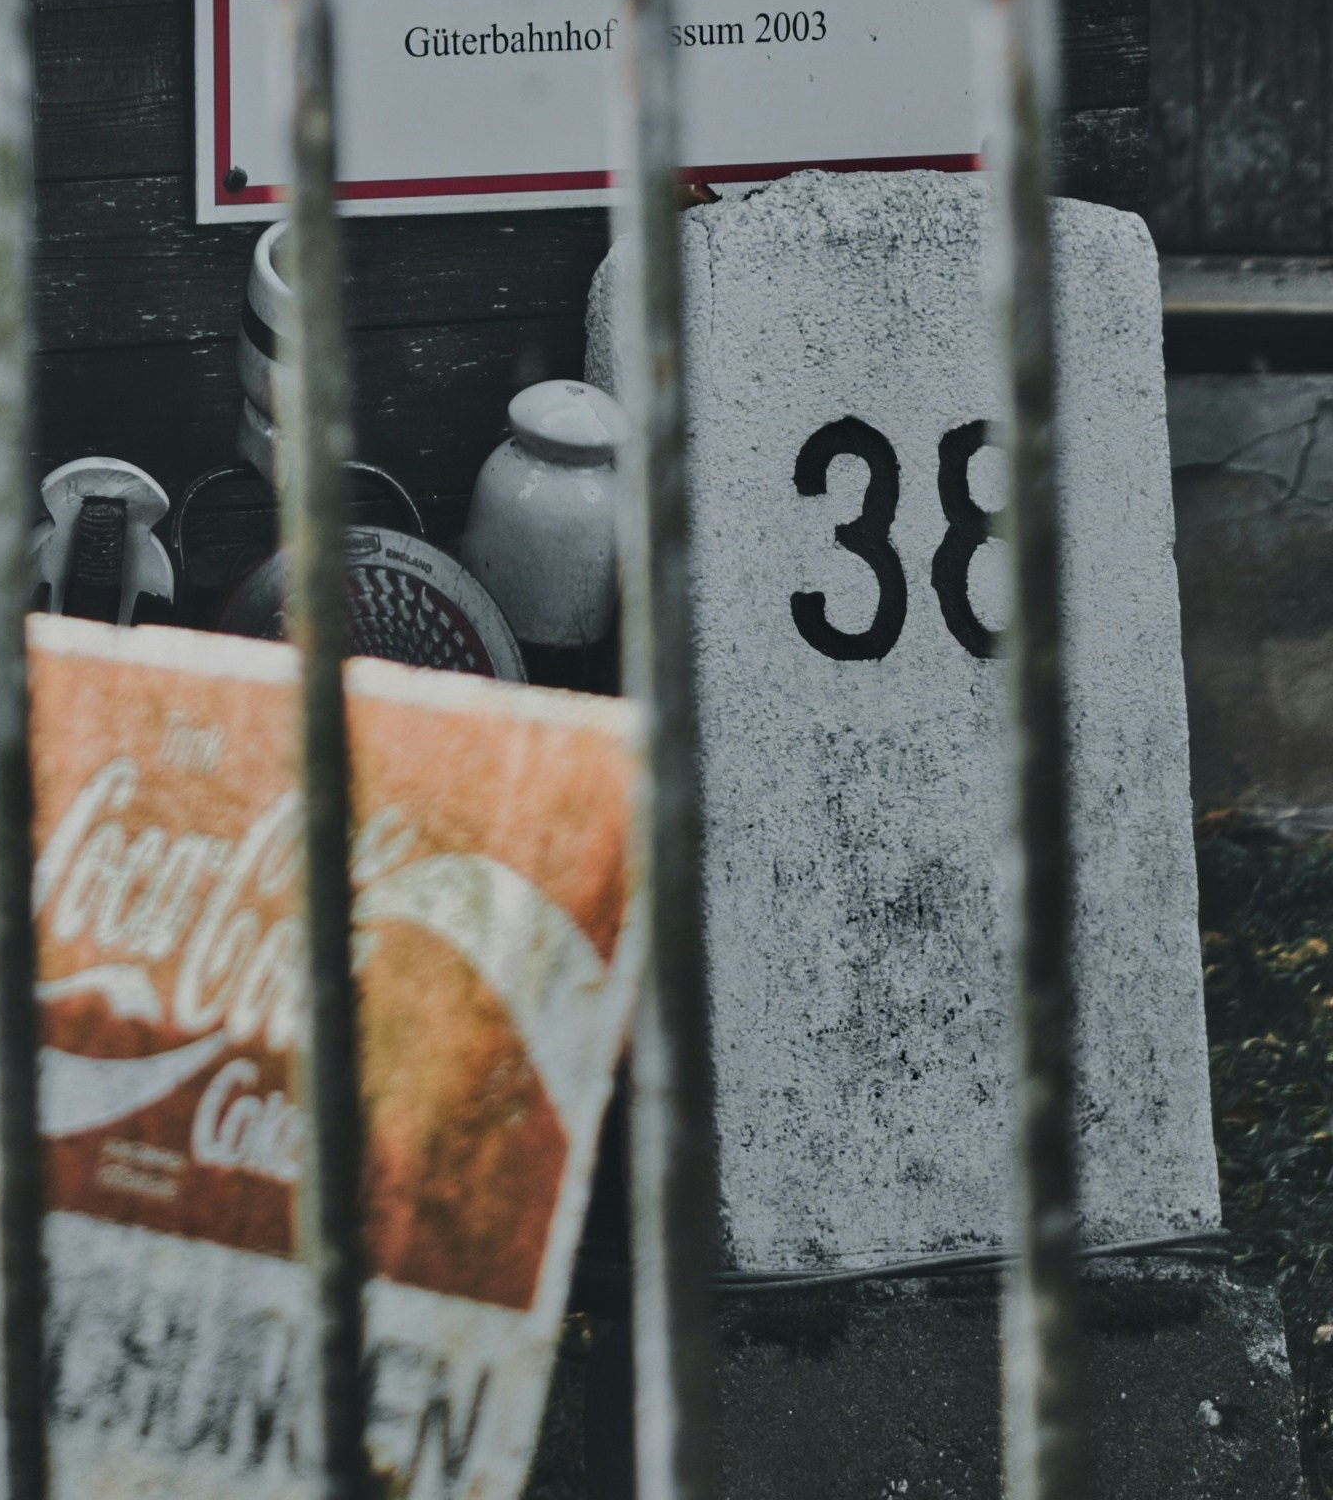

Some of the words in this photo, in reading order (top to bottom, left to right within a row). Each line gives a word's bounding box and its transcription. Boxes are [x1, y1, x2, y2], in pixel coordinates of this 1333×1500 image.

[403, 18, 619, 59] Güterbahnhof
[754, 10, 827, 44] 2003
[385, 547, 434, 575] ENGLAND
